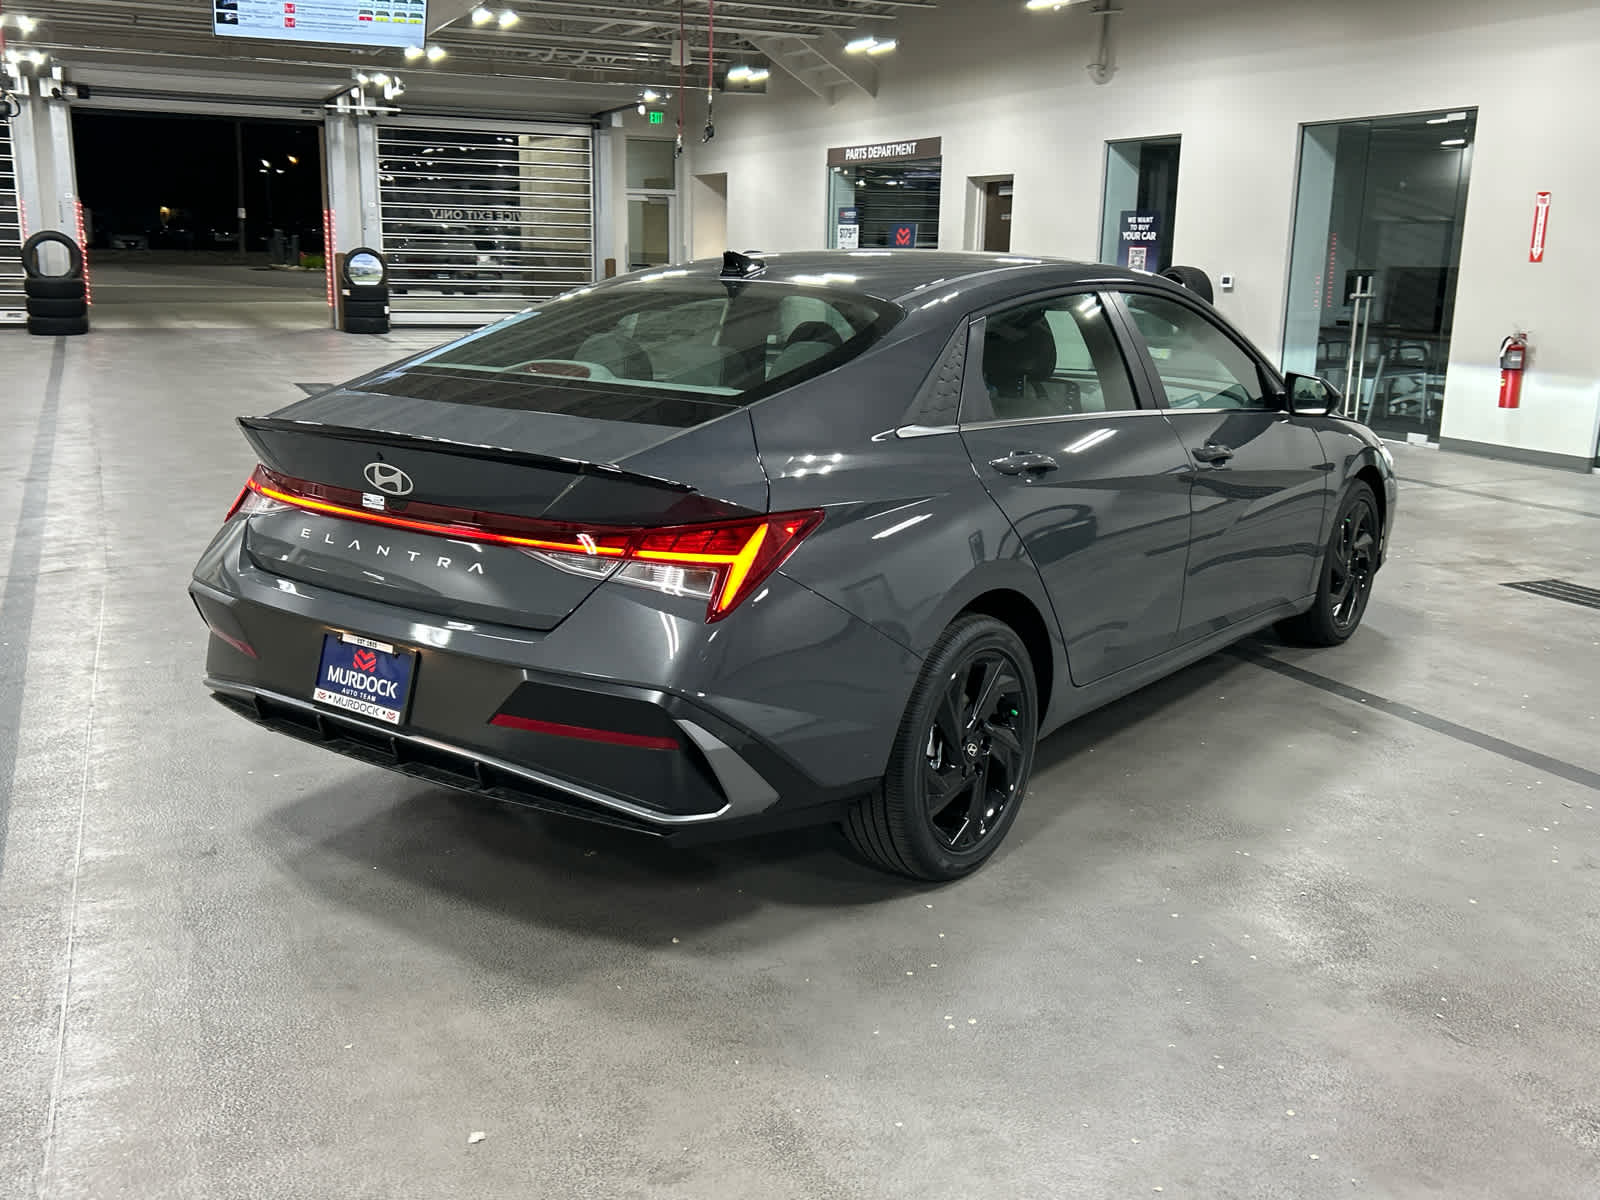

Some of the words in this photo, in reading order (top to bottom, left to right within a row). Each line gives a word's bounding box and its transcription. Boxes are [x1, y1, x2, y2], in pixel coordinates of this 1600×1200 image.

[649, 111, 664, 124] EXIT
[845, 147, 867, 160] PARTS
[868, 142, 917, 158] DEPARTMENT
[1122, 231, 1140, 240] YOUR
[1141, 231, 1157, 240] CAR
[300, 528, 484, 575] ELANTRA
[327, 665, 398, 699] MURDOCK
[341, 687, 358, 697] AUTO
[360, 692, 377, 702] TEAM
[333, 696, 380, 716] MURDOCK
